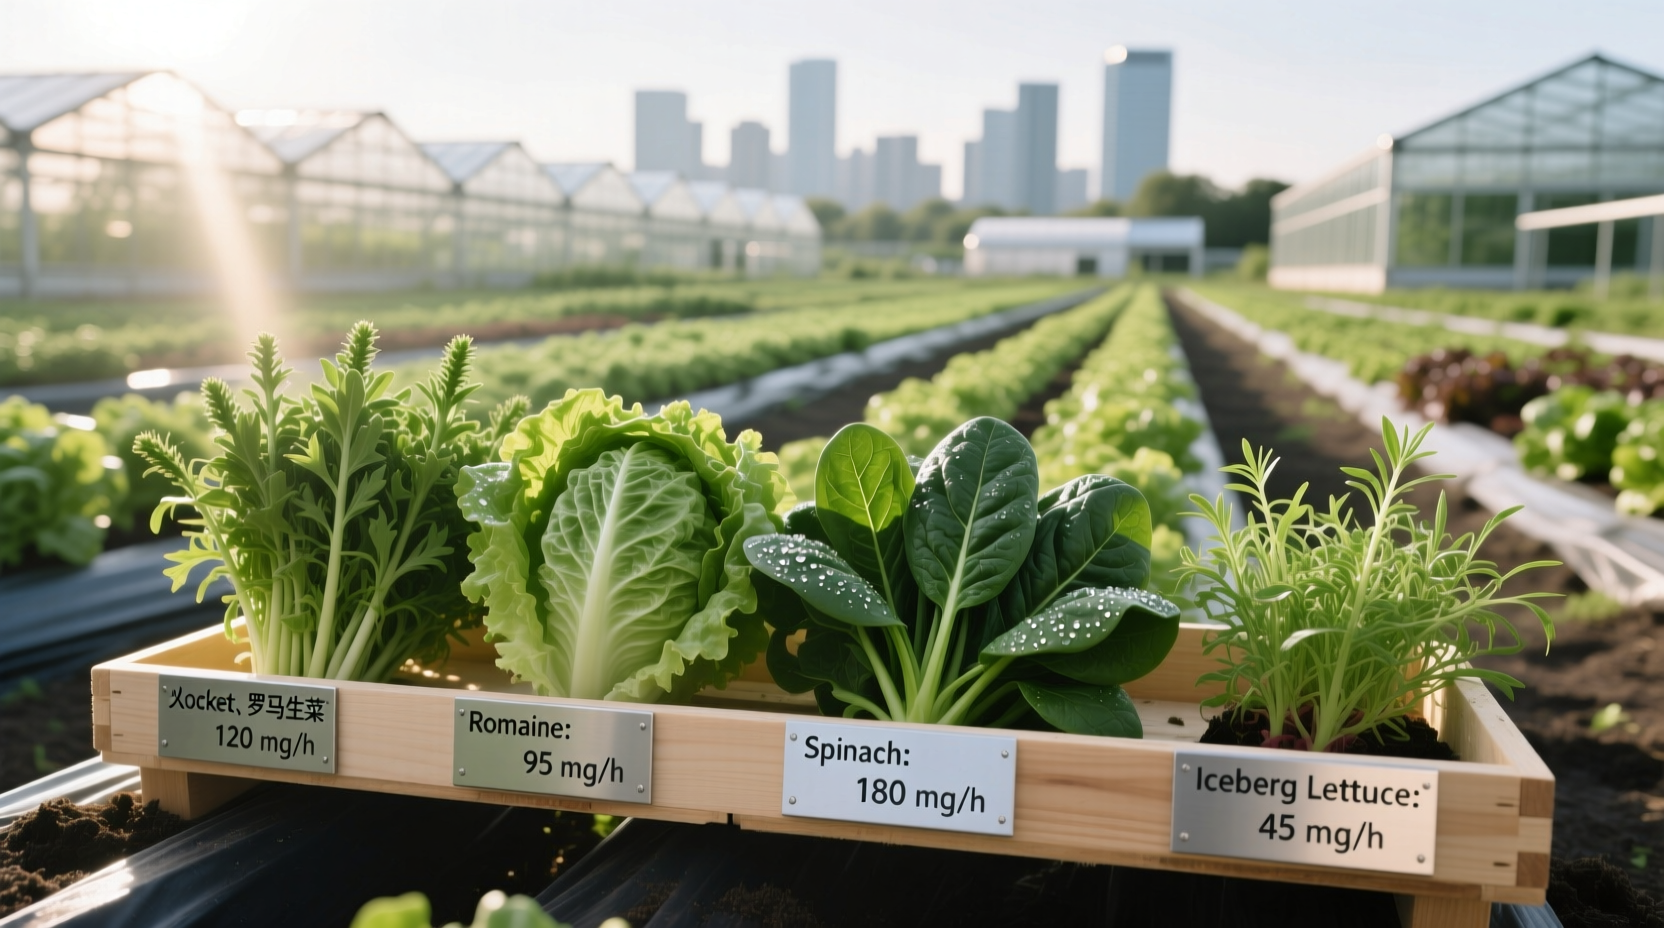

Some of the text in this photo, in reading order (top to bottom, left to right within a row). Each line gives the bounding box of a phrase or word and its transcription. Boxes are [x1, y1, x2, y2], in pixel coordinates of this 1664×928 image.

[216, 724, 315, 760] 120 mg/h
[469, 710, 571, 739] Romaine:
[523, 750, 624, 787] 95 mg/h
[804, 735, 910, 766] Spinach:
[857, 777, 985, 817] 180 mg/h
[1196, 766, 1420, 808] Iceberg Lettuce:
[1258, 813, 1384, 854] 45 mg/h
